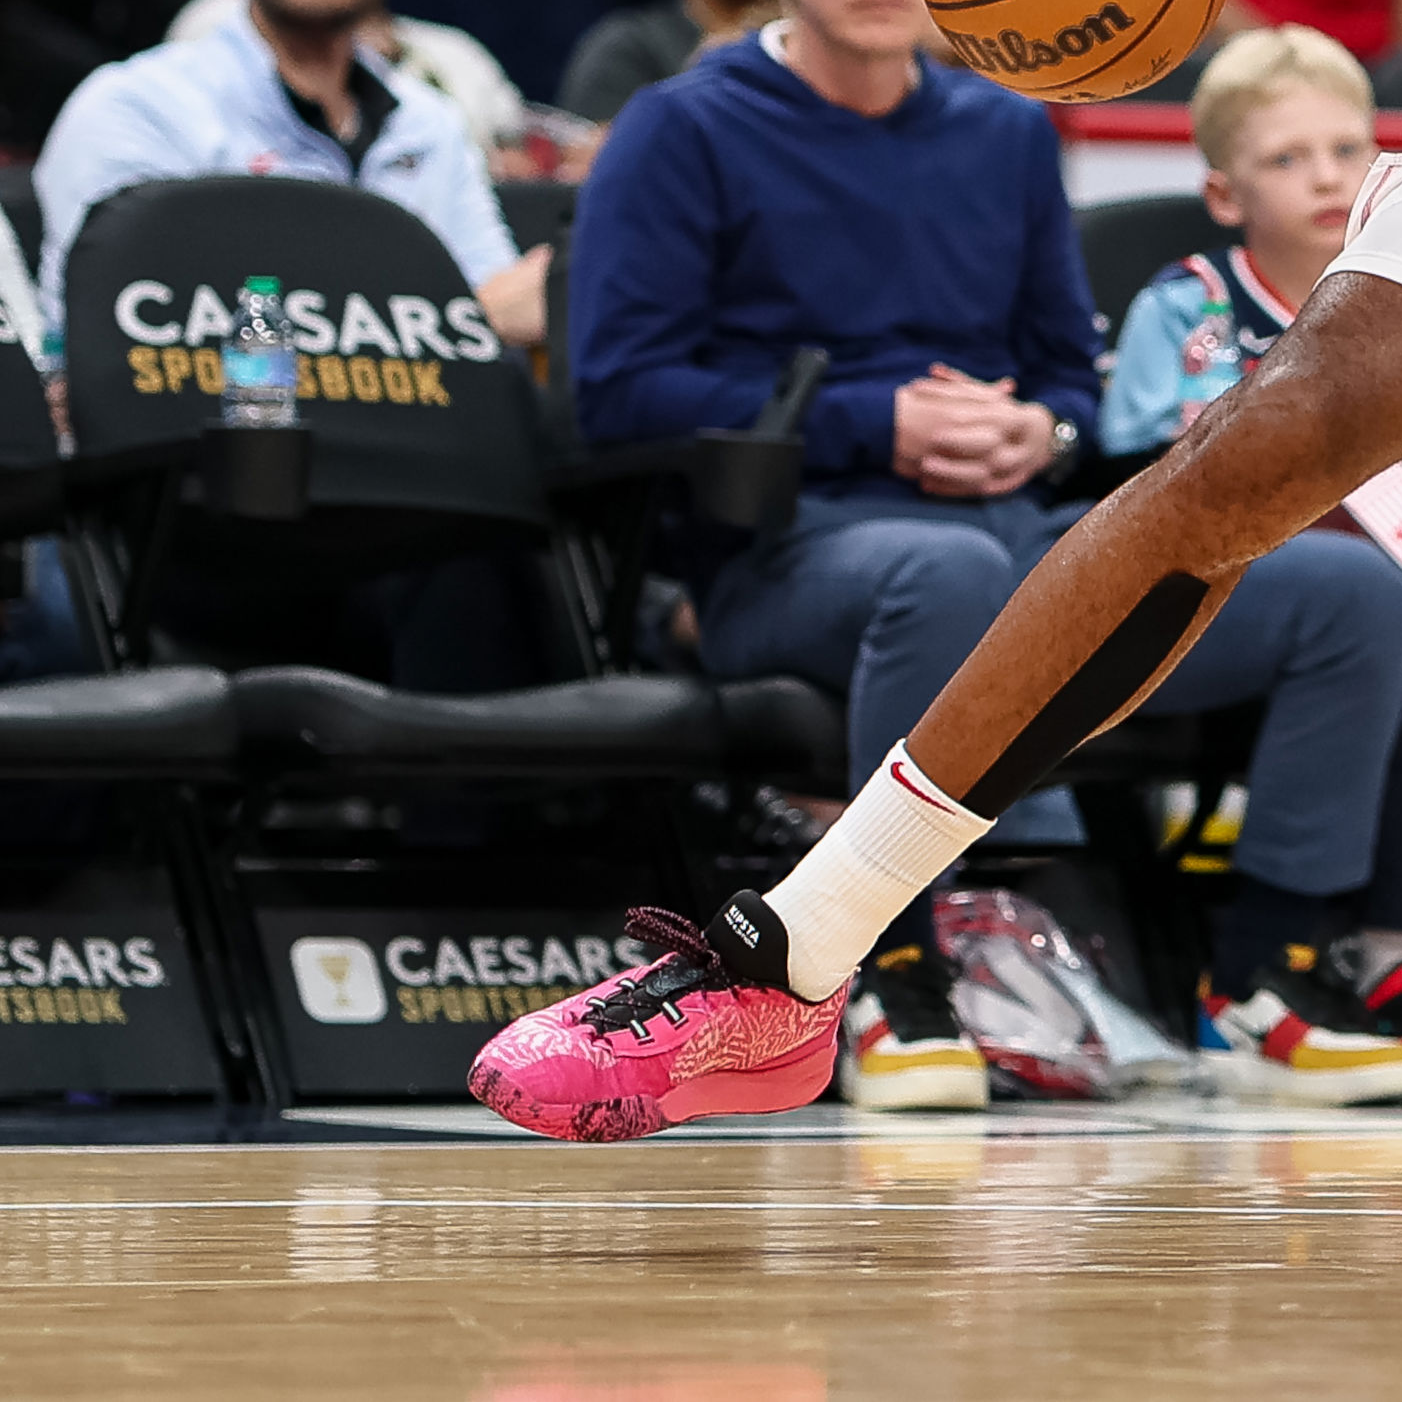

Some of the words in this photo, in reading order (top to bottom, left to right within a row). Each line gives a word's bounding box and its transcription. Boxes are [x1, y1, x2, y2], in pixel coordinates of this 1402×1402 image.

[114, 279, 502, 363] CASARS
[128, 345, 452, 407] SPOSBOOK
[729, 905, 760, 944] KIPSTA
